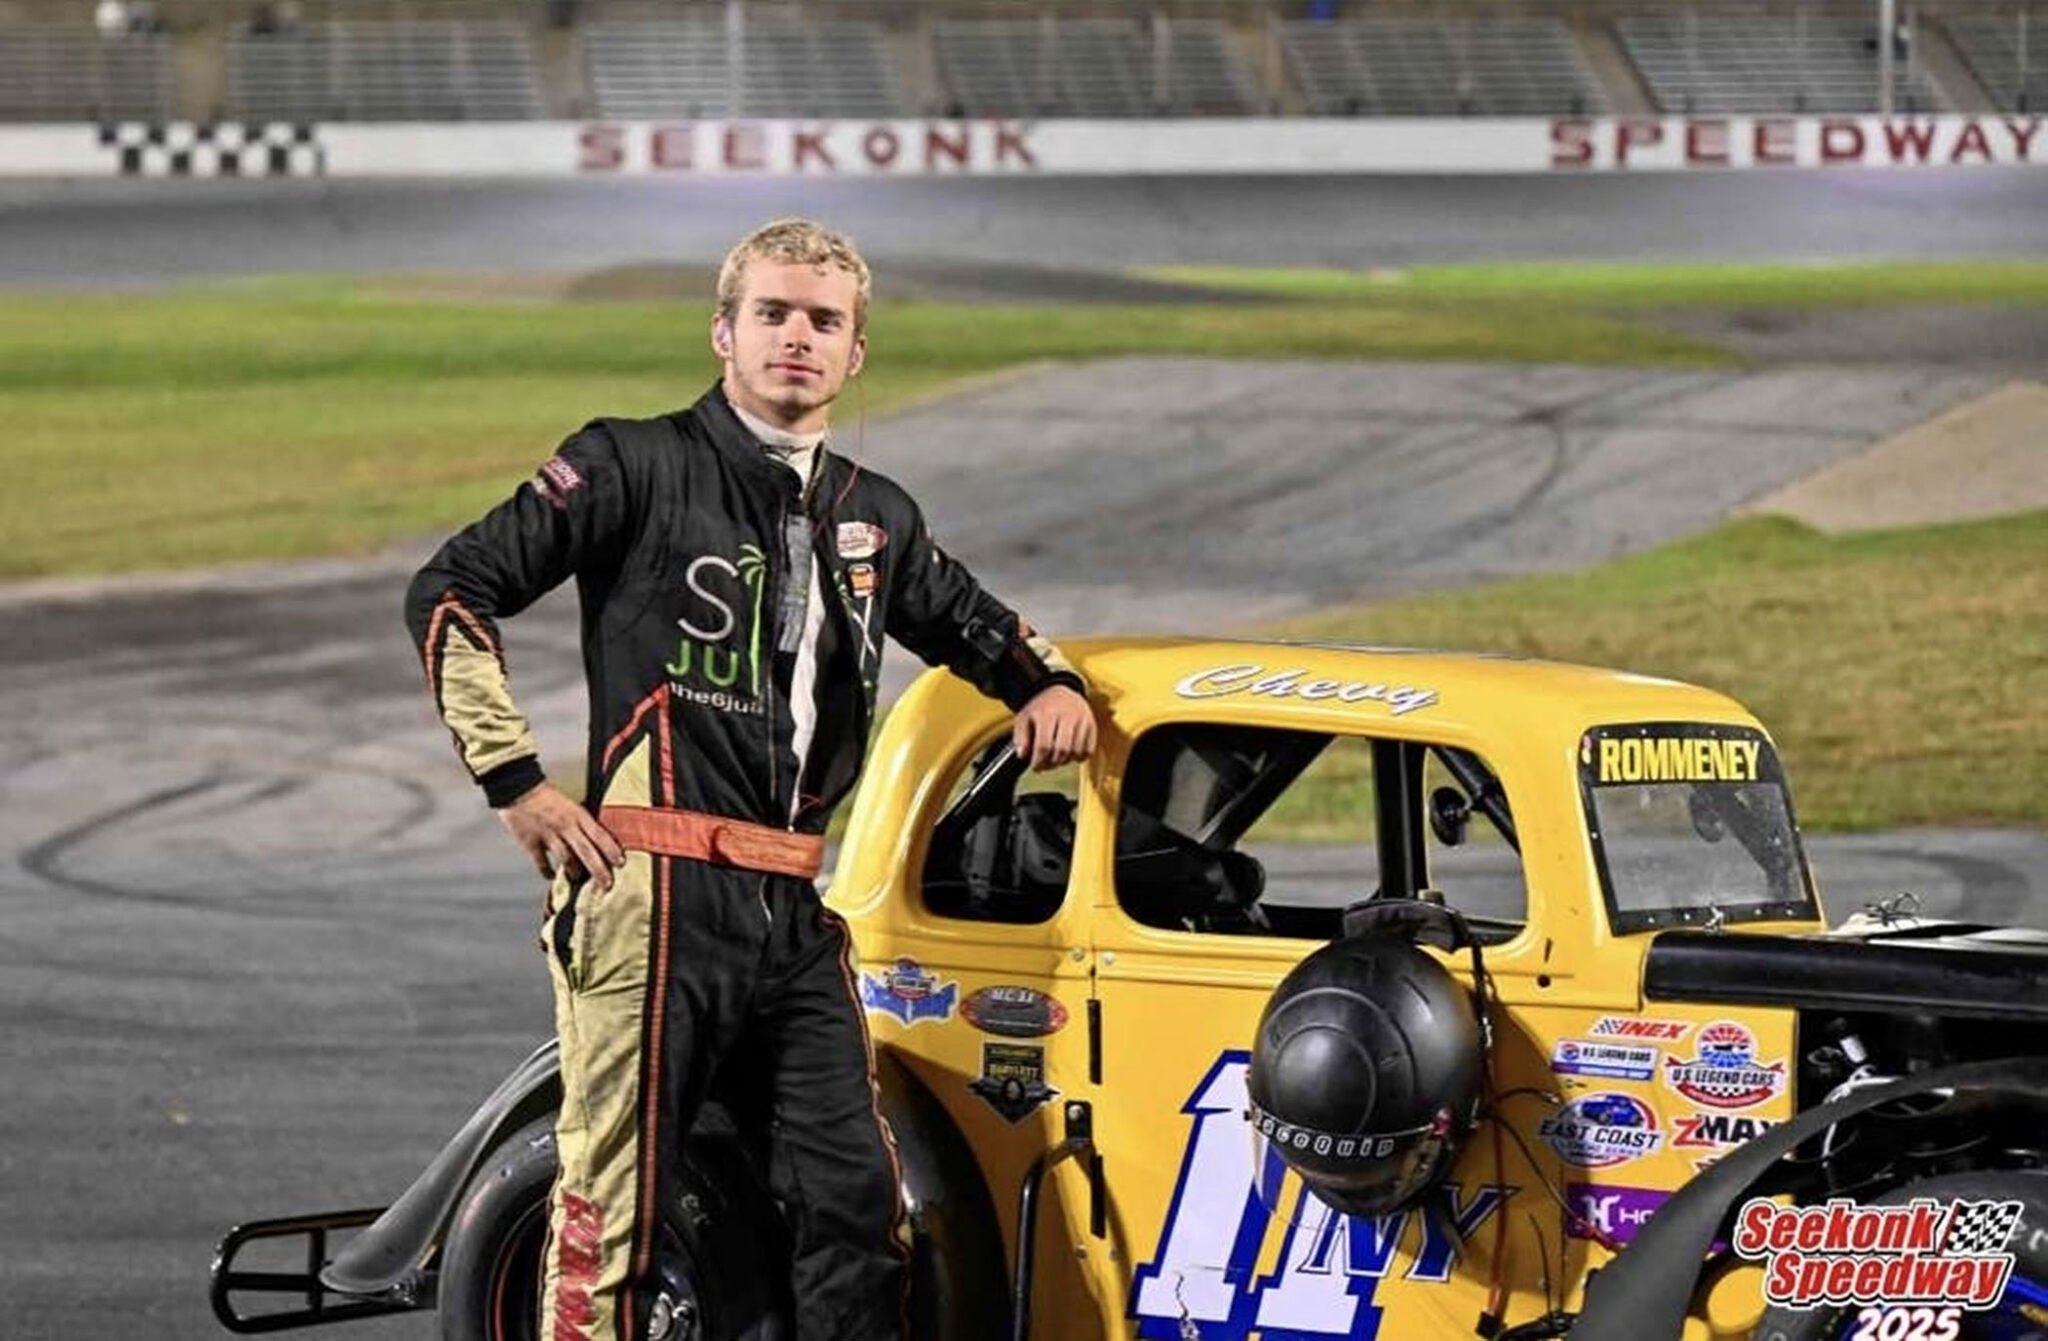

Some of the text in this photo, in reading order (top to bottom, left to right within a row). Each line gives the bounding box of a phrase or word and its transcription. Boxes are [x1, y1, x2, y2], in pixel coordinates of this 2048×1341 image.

[578, 117, 2043, 171] SEEKONK SPEEDWAY
[1175, 664, 1440, 716] Chevy
[1600, 737, 1761, 782] ROMMENEY
[1616, 1019, 1688, 1040] INEX
[1695, 1069, 1740, 1085] LEGEND
[1742, 1072, 1776, 1087] CARS
[1540, 1118, 1660, 1150] EAST COAST
